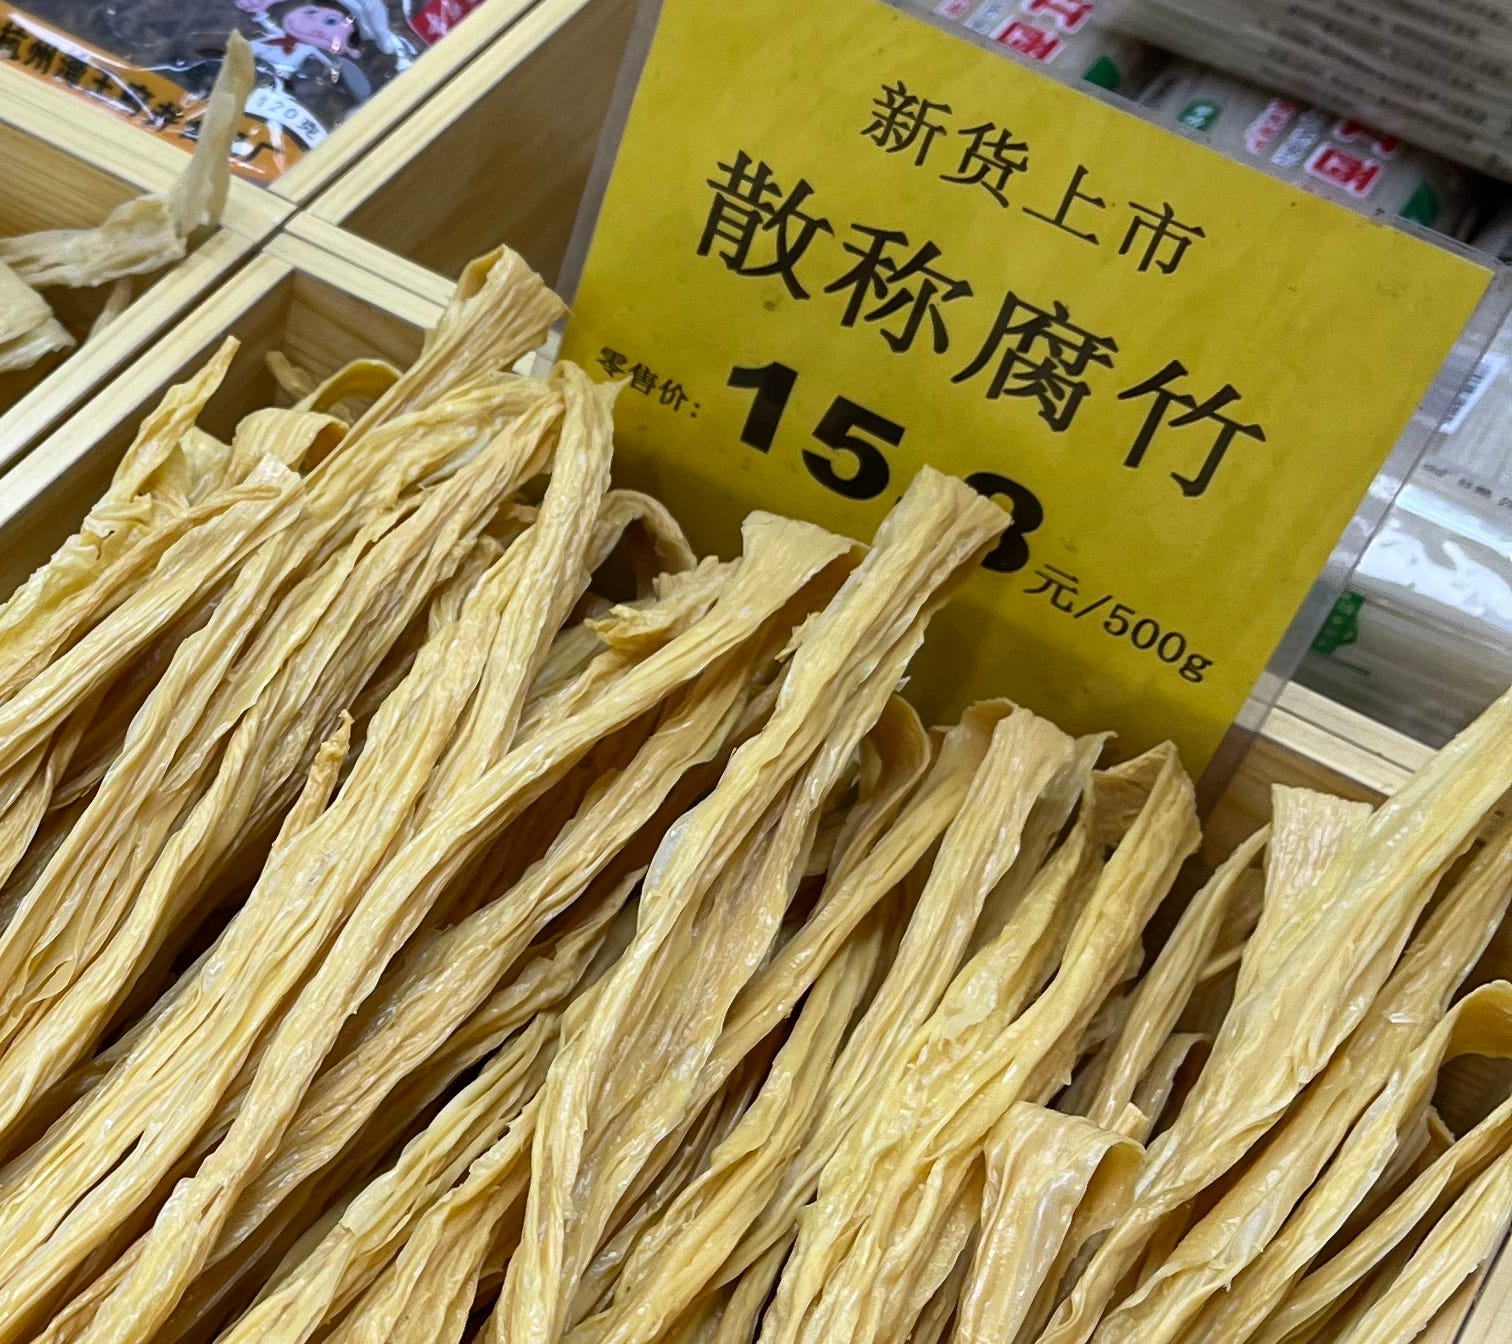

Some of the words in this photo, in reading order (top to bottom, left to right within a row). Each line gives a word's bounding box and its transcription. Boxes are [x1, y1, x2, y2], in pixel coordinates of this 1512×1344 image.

[860, 80, 1207, 278] 新货上市
[694, 149, 1269, 498] 散称腐竹
[595, 346, 701, 418] 零售价:
[725, 361, 1044, 574] 158
